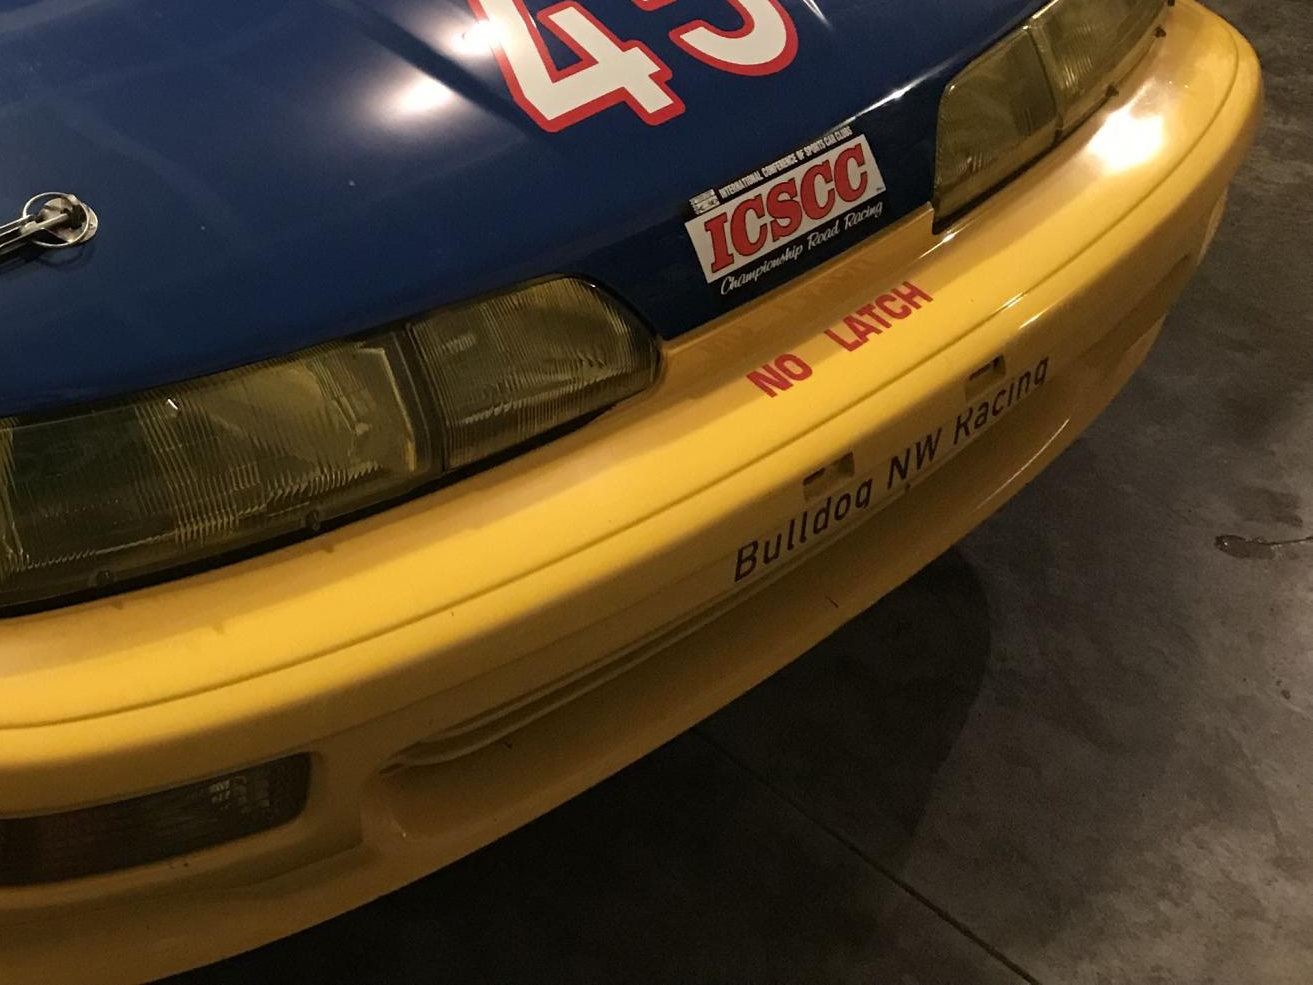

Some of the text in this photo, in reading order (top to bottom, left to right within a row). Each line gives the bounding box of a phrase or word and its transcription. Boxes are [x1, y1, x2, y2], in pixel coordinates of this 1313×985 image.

[704, 143, 869, 274] ICSCC
[718, 169, 764, 200] INTERNATIONAL
[760, 152, 798, 179] CONFERENCE
[803, 138, 827, 157] SPORTS
[834, 125, 853, 144] CLUBS
[720, 200, 884, 295] Championship Road Racing
[746, 280, 935, 398] NO LATCH
[733, 357, 1050, 583] Bulldog NW Racing
